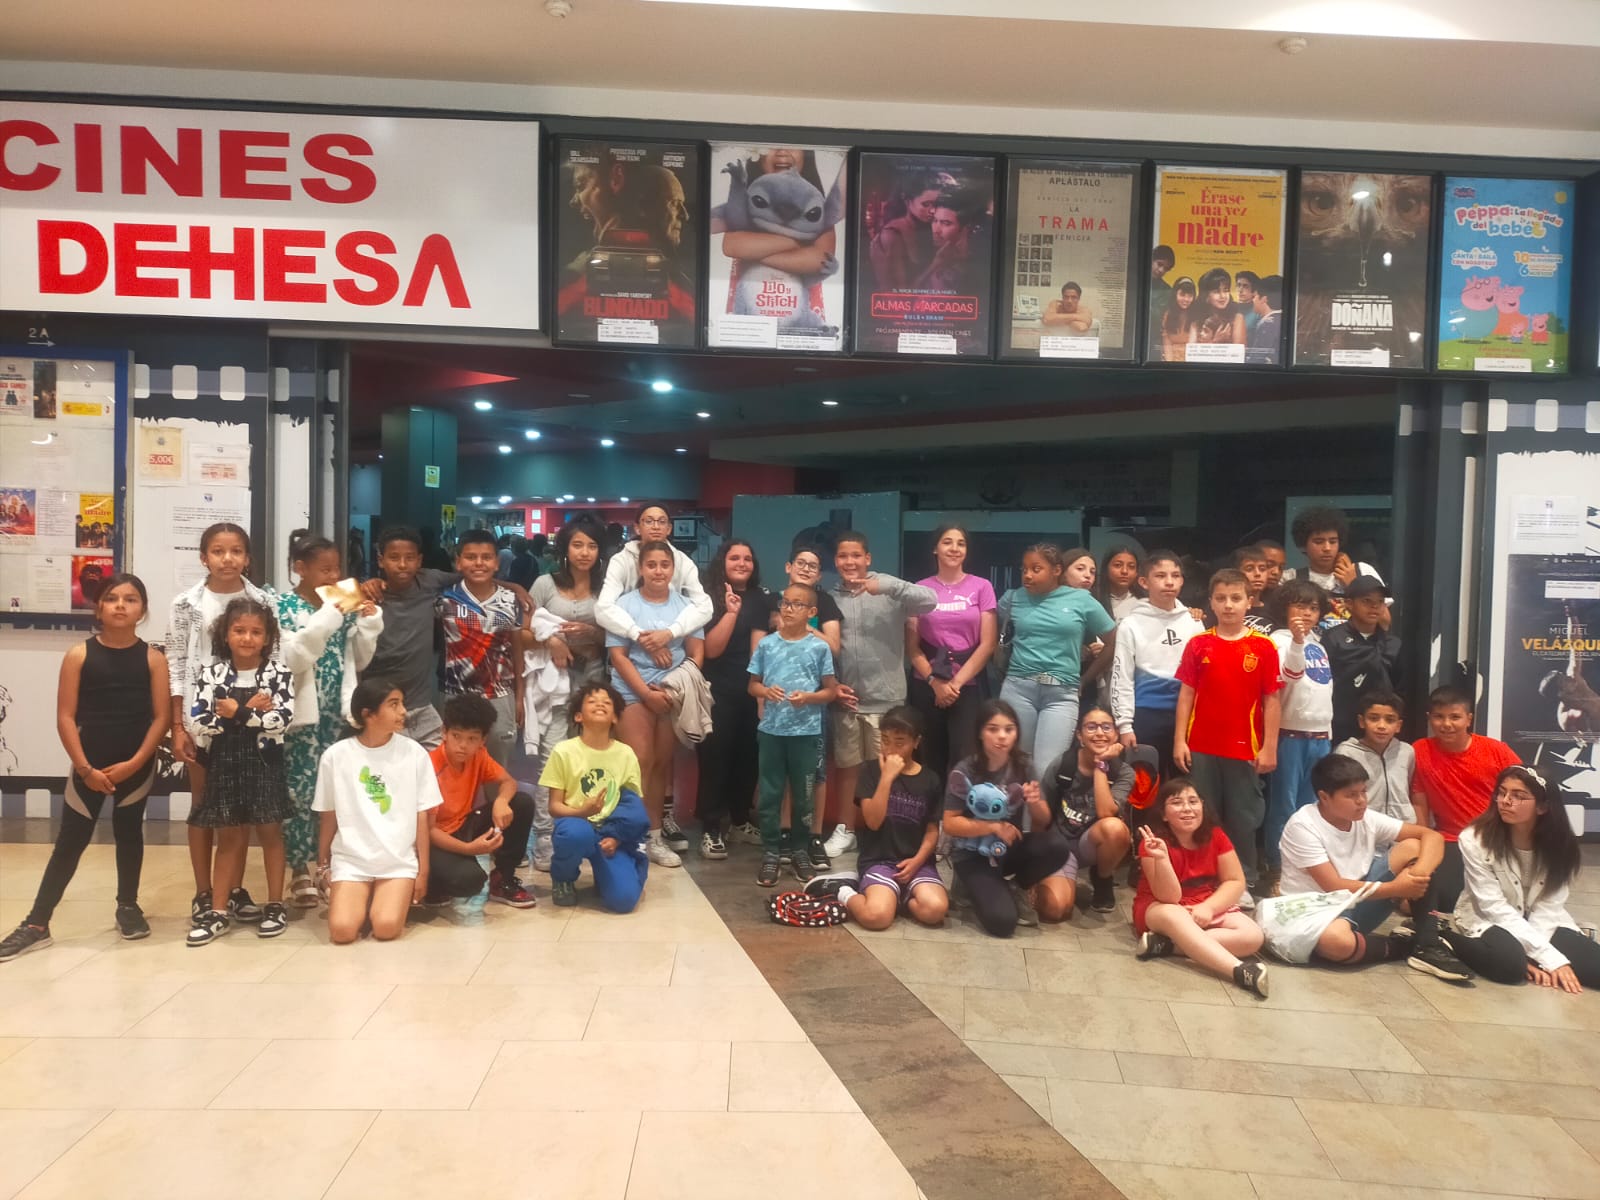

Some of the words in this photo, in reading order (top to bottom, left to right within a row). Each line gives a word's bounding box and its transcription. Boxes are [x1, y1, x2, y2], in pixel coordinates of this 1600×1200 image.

[0, 119, 377, 204] CINES
[1049, 176, 1101, 187] APLÁSTALO
[1200, 186, 1246, 205] Érase
[1191, 205, 1222, 216] una
[1226, 206, 1248, 217] vez
[1039, 215, 1109, 231] TRAMA
[1205, 216, 1229, 228] mi
[1055, 233, 1091, 241] FENICIA
[1177, 222, 1265, 247] Madre
[37, 219, 472, 309] DEHESA
[583, 296, 669, 320] BLINDADO
[875, 301, 911, 311] ALMAS
[914, 300, 974, 313] MARCADAS
[1331, 302, 1393, 327] DOÑANA
[456, 603, 468, 618] 10
[1549, 627, 1588, 636] MIGUEL
[1306, 659, 1330, 669] NAS
